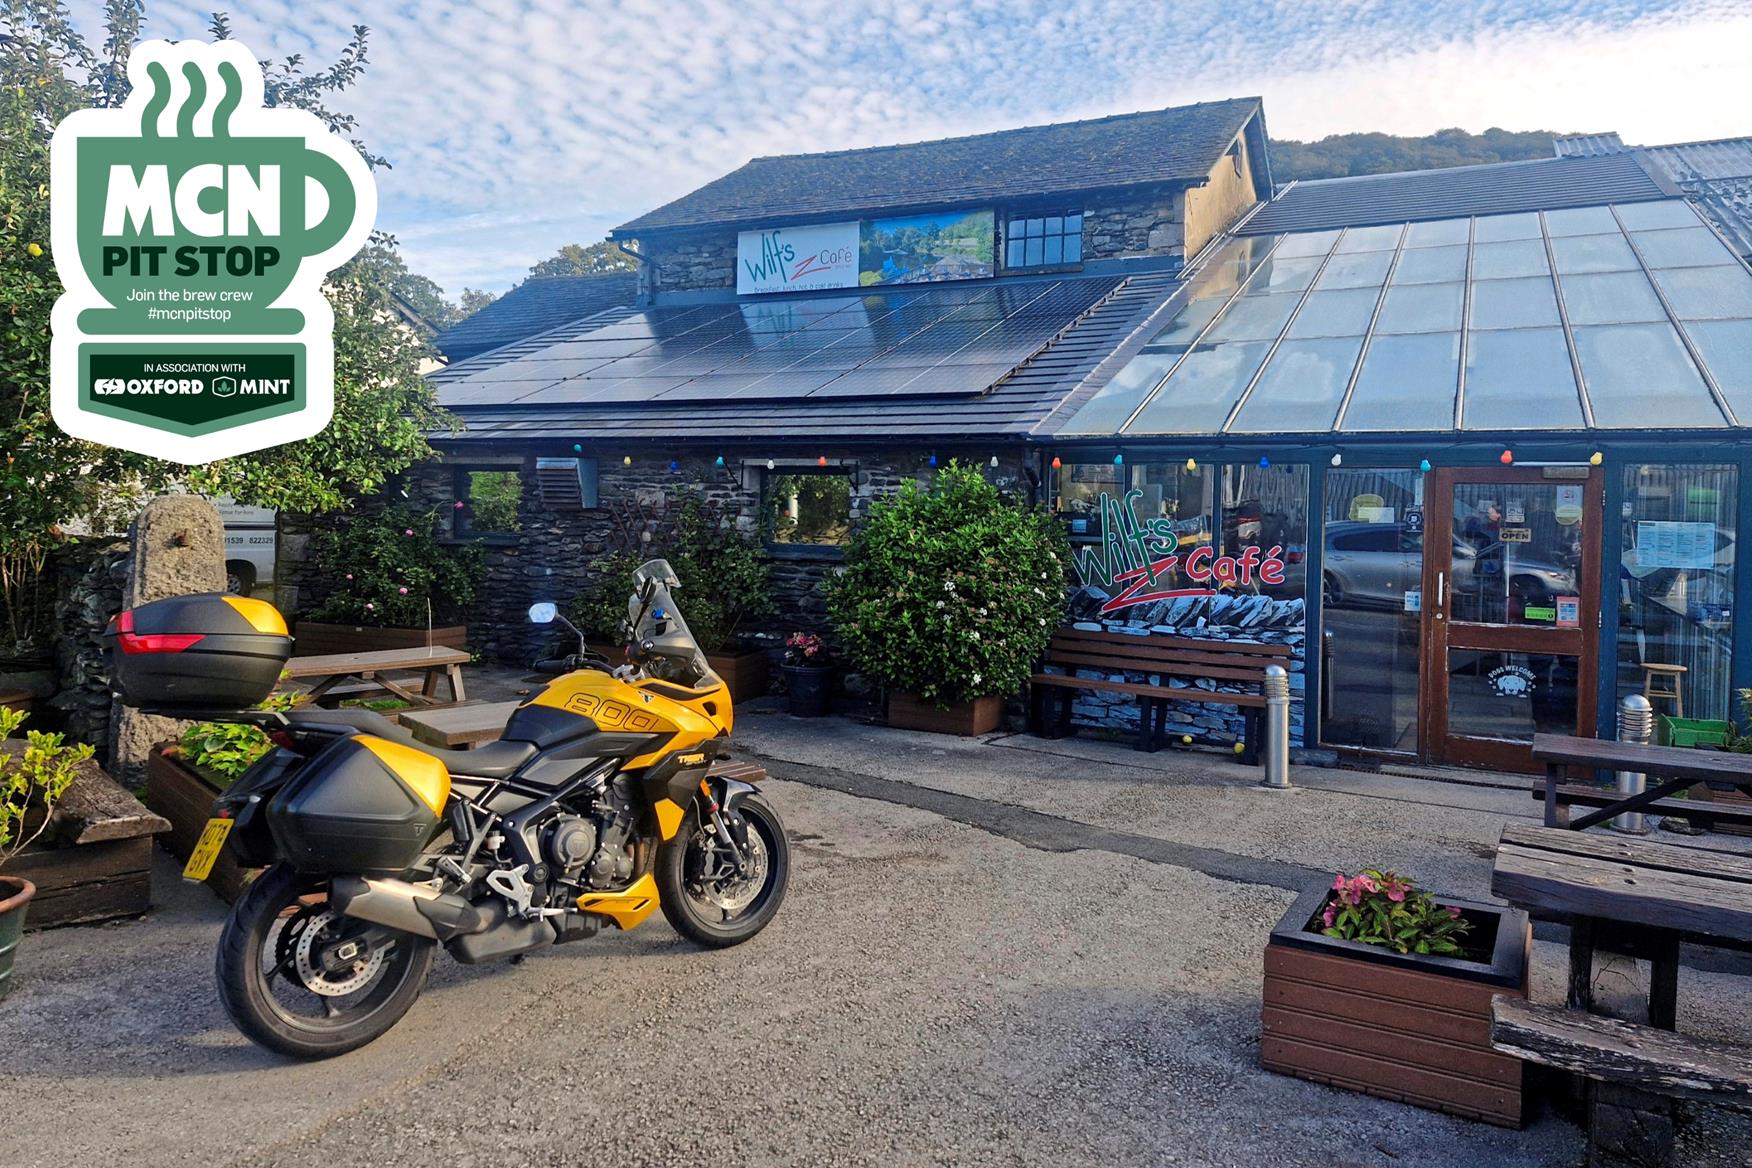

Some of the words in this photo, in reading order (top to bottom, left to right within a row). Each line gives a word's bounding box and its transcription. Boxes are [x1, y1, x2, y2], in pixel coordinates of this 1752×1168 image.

[744, 230, 795, 283] Wilf's
[820, 246, 852, 265] Café
[1067, 489, 1179, 587] Wilf's
[1185, 545, 1286, 586] Café
[1501, 532, 1529, 540] OPEN
[1488, 666, 1504, 678] DOGS
[1505, 665, 1536, 680] WELCOME
[564, 692, 658, 730] 800
